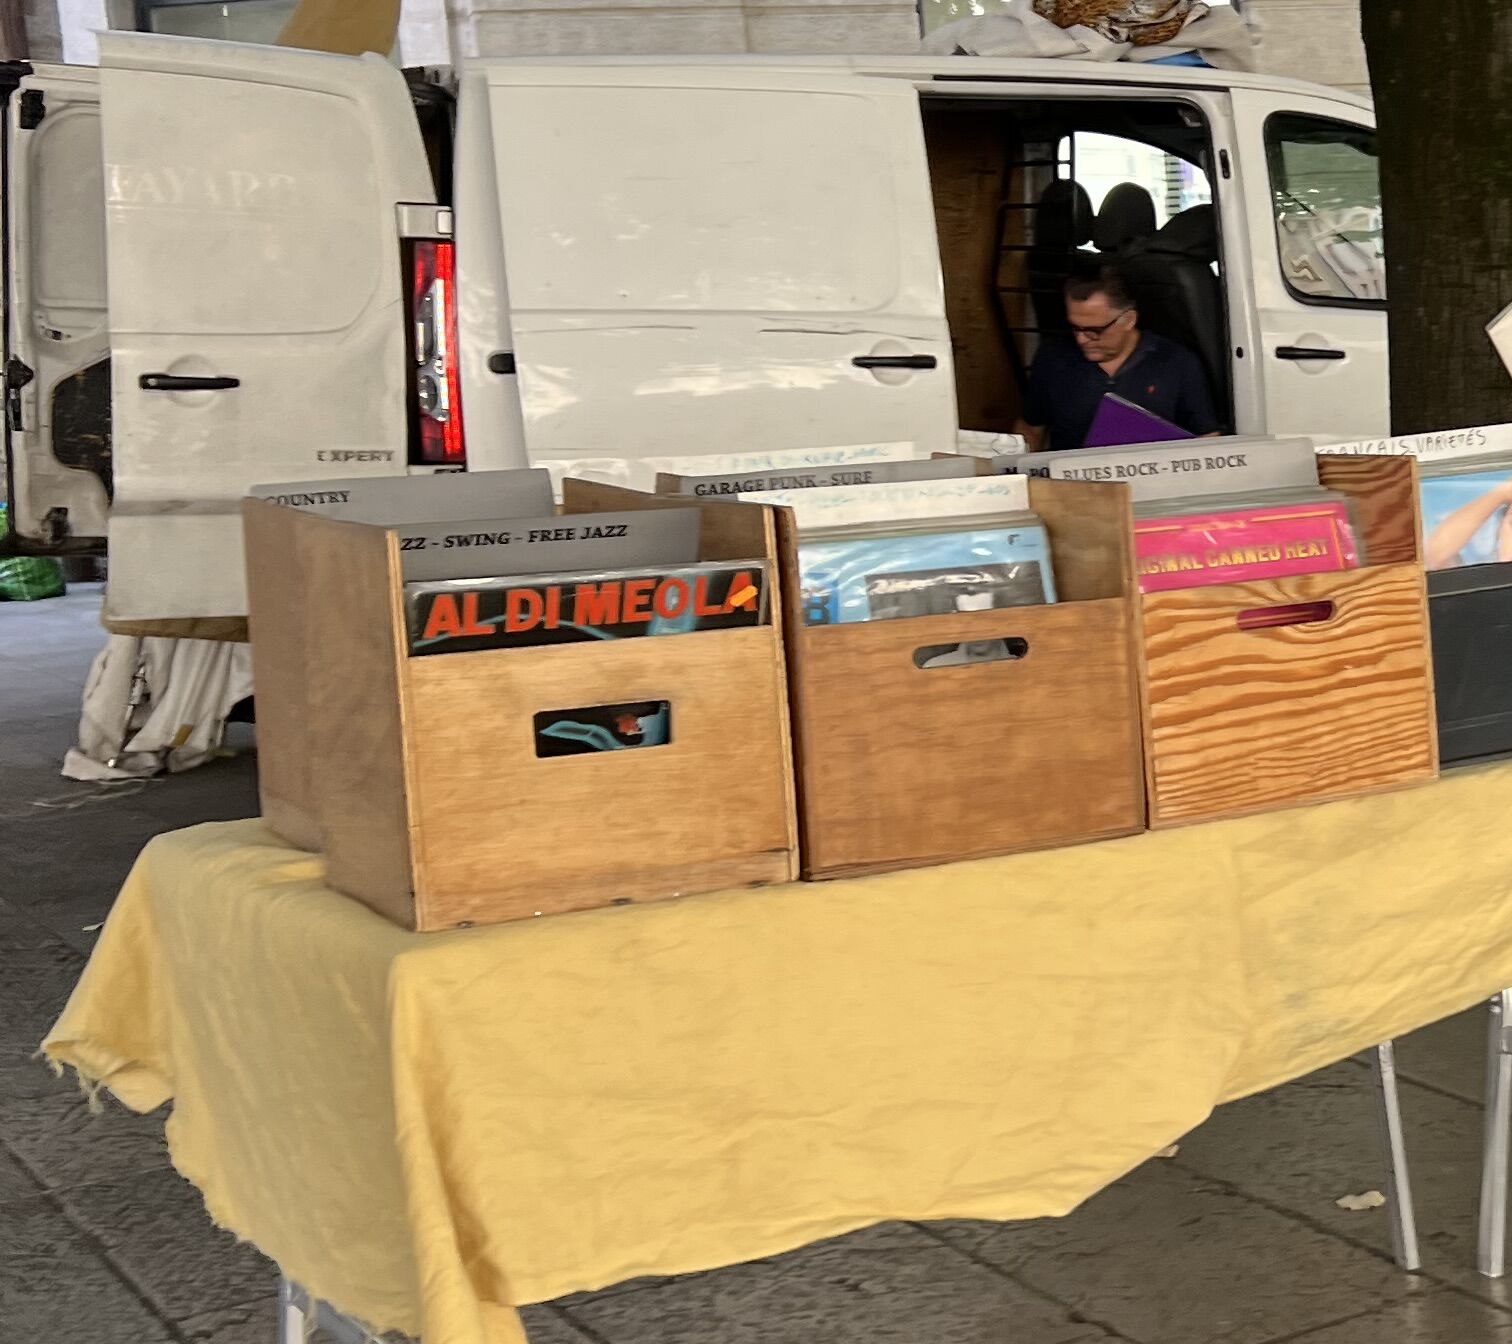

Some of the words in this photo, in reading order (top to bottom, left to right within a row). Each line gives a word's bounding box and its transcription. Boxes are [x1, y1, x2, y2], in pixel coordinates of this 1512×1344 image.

[317, 450, 394, 462] EXPERT
[1062, 467, 1112, 481] BLUES
[1116, 462, 1159, 478] ROCK
[1172, 458, 1201, 473] PUB
[1206, 454, 1247, 470] ROCK
[694, 479, 766, 497] GARAGE
[769, 474, 817, 491] PUNK
[831, 471, 873, 486] SURF
[444, 532, 511, 549] SWING
[528, 527, 576, 543] FREE
[580, 524, 628, 540] JAZZ
[1284, 539, 1329, 560] HEAT
[421, 592, 496, 640] AL
[504, 586, 562, 634] DI
[573, 571, 758, 627] MEOLA
